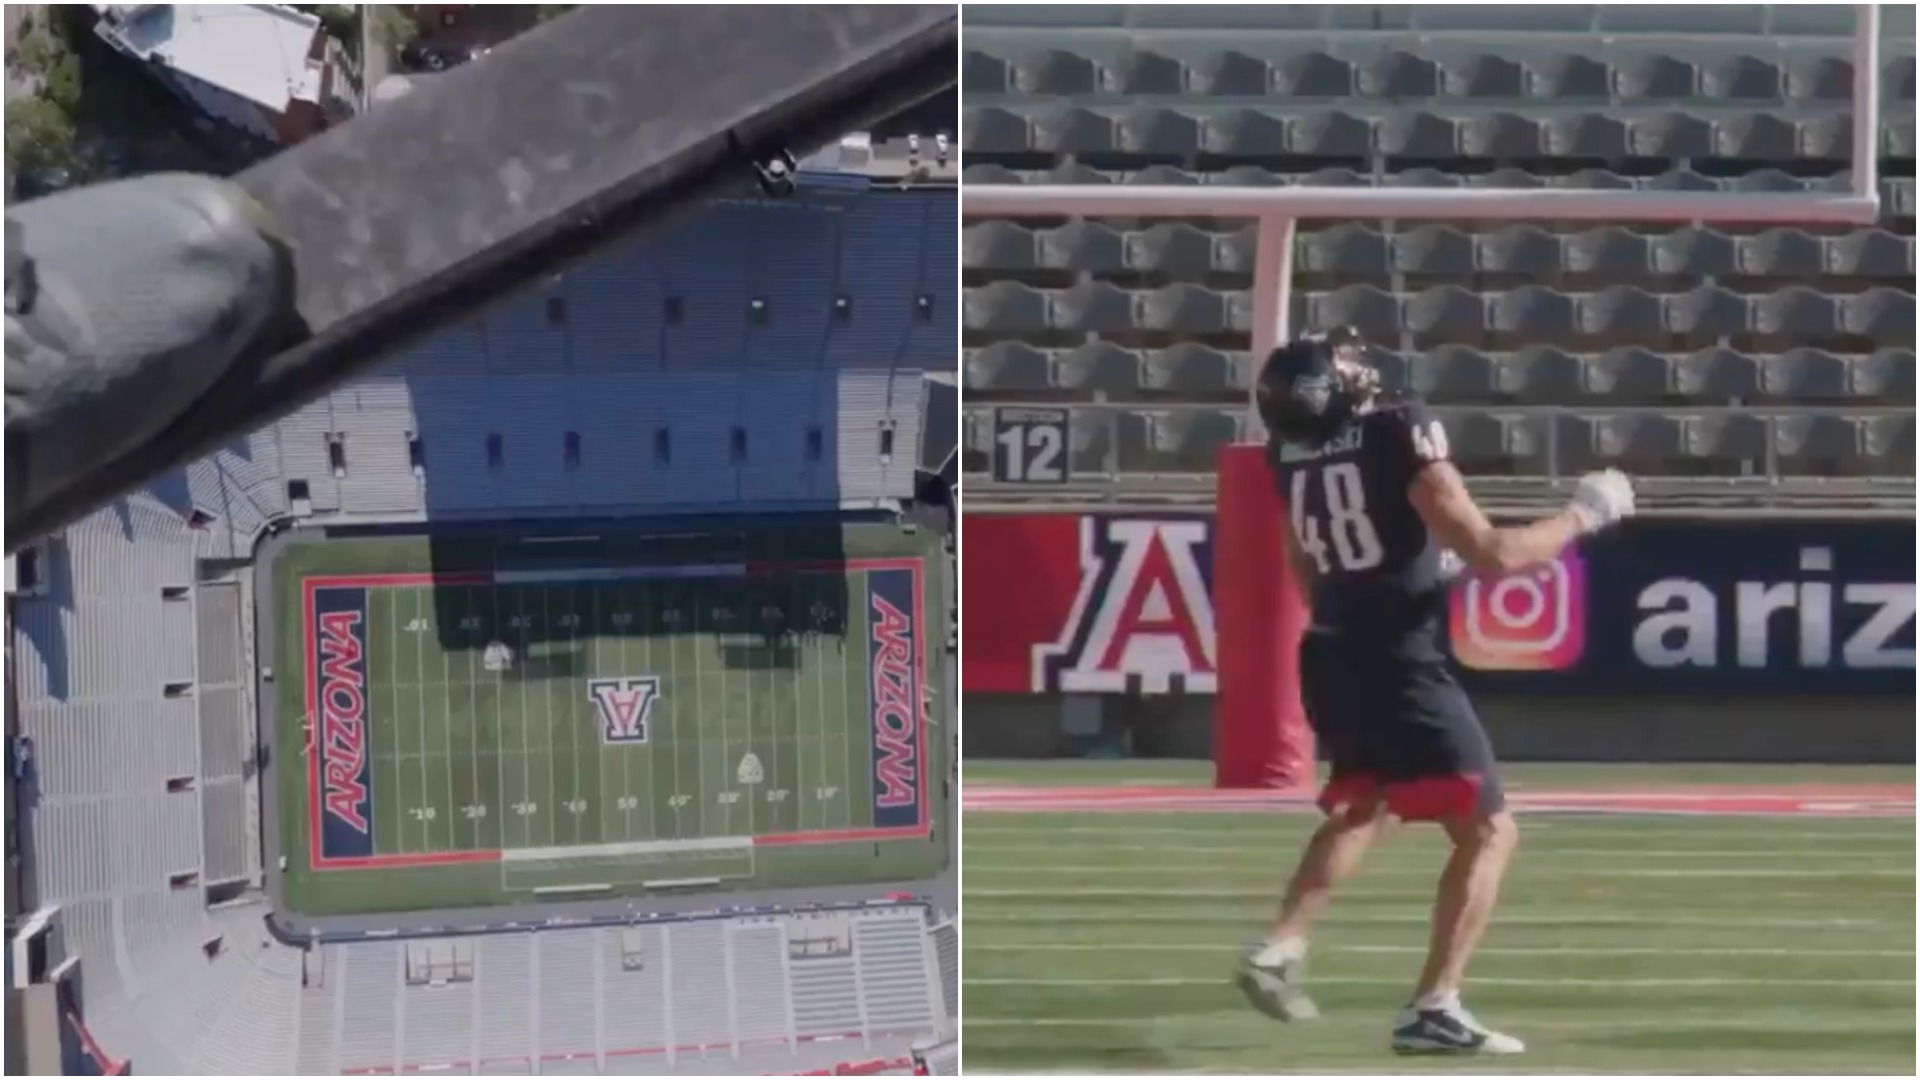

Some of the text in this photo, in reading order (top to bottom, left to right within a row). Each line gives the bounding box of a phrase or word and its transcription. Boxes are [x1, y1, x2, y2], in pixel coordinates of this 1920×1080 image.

[996, 425, 1063, 481] 12
[1290, 462, 1384, 575] 48
[1033, 516, 1218, 693] A
[1633, 547, 1917, 668] ariz
[319, 610, 368, 833] ARIZONA
[587, 675, 659, 743] A
[871, 591, 915, 808] ARIZONA
[617, 796, 638, 810] 50
